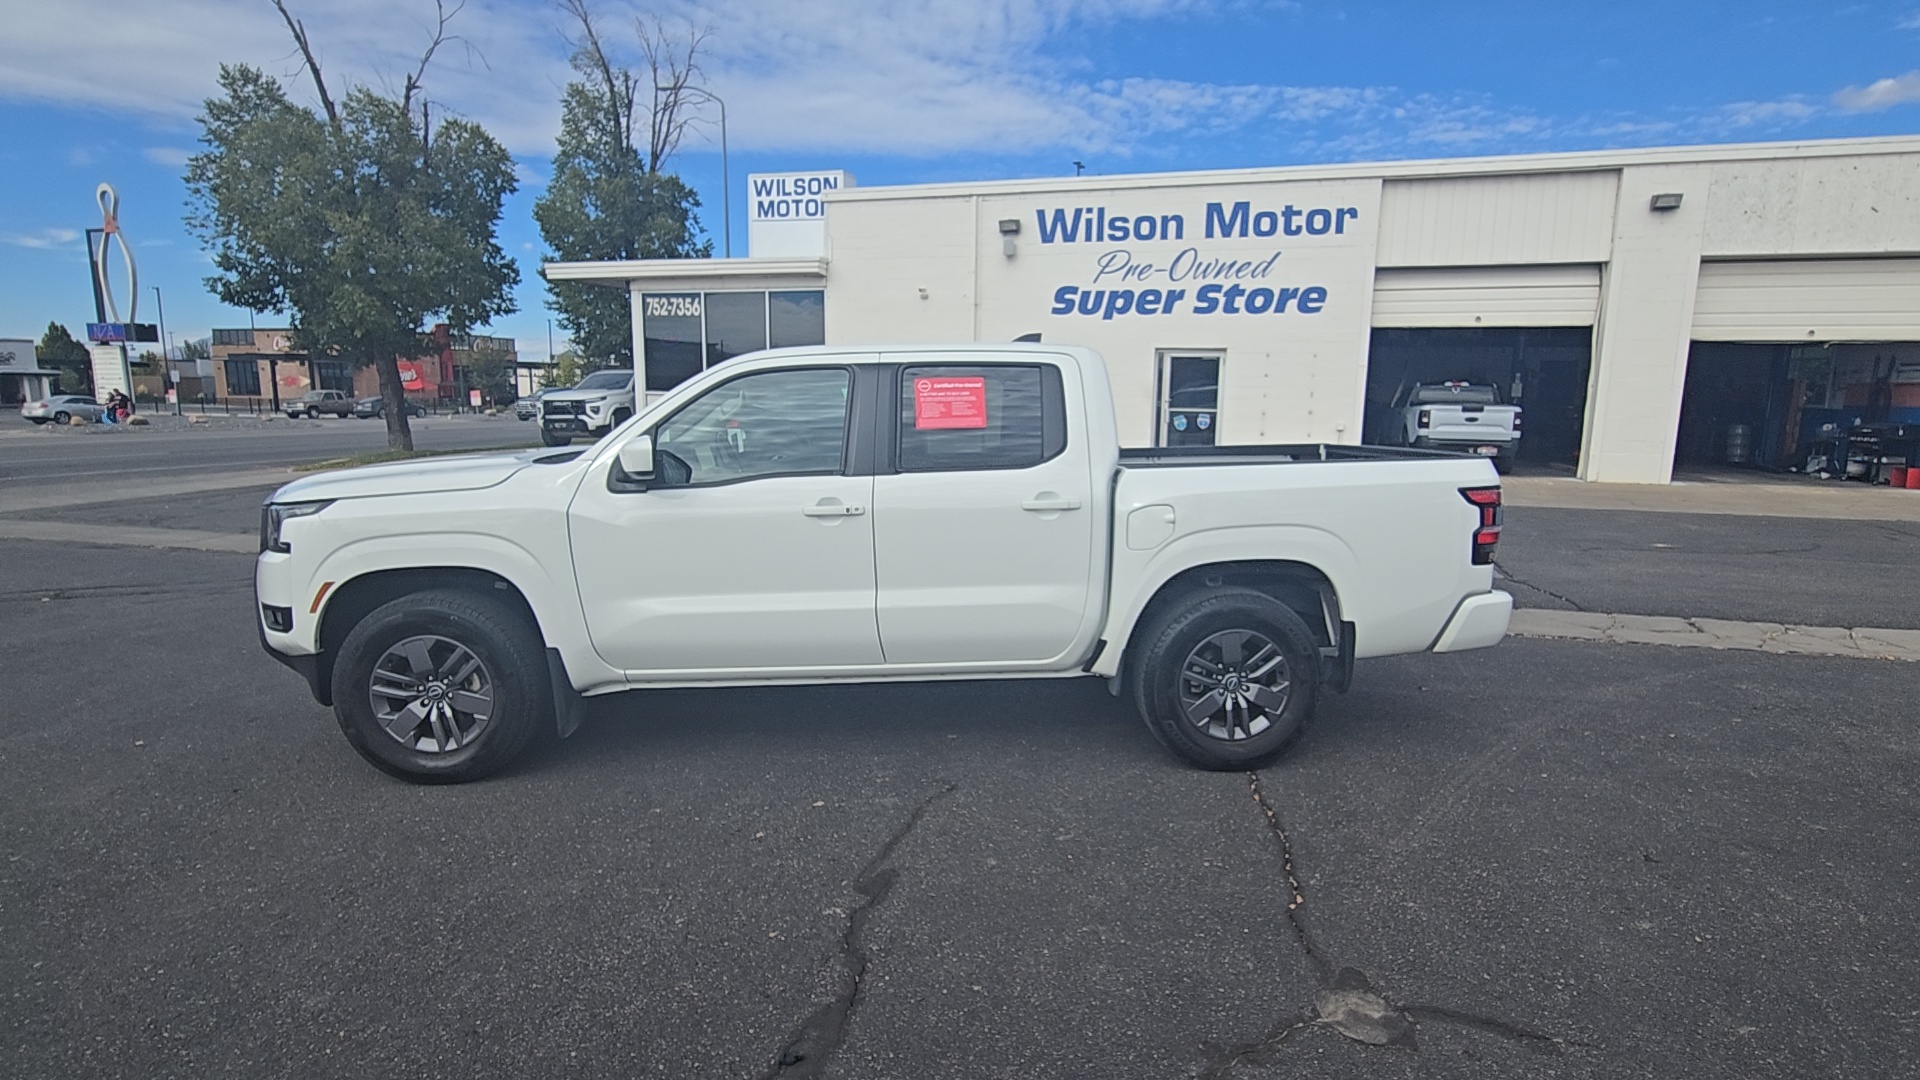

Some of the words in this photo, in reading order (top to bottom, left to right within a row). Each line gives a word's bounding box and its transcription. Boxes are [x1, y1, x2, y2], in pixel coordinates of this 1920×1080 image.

[753, 176, 838, 197] WILSON
[1036, 207, 1184, 244] Wilson
[1204, 201, 1358, 239] Motor
[1093, 247, 1282, 284] Pre-Owned
[646, 297, 700, 317] 752-7356
[1051, 285, 1186, 320] Super
[1193, 283, 1328, 315] Store
